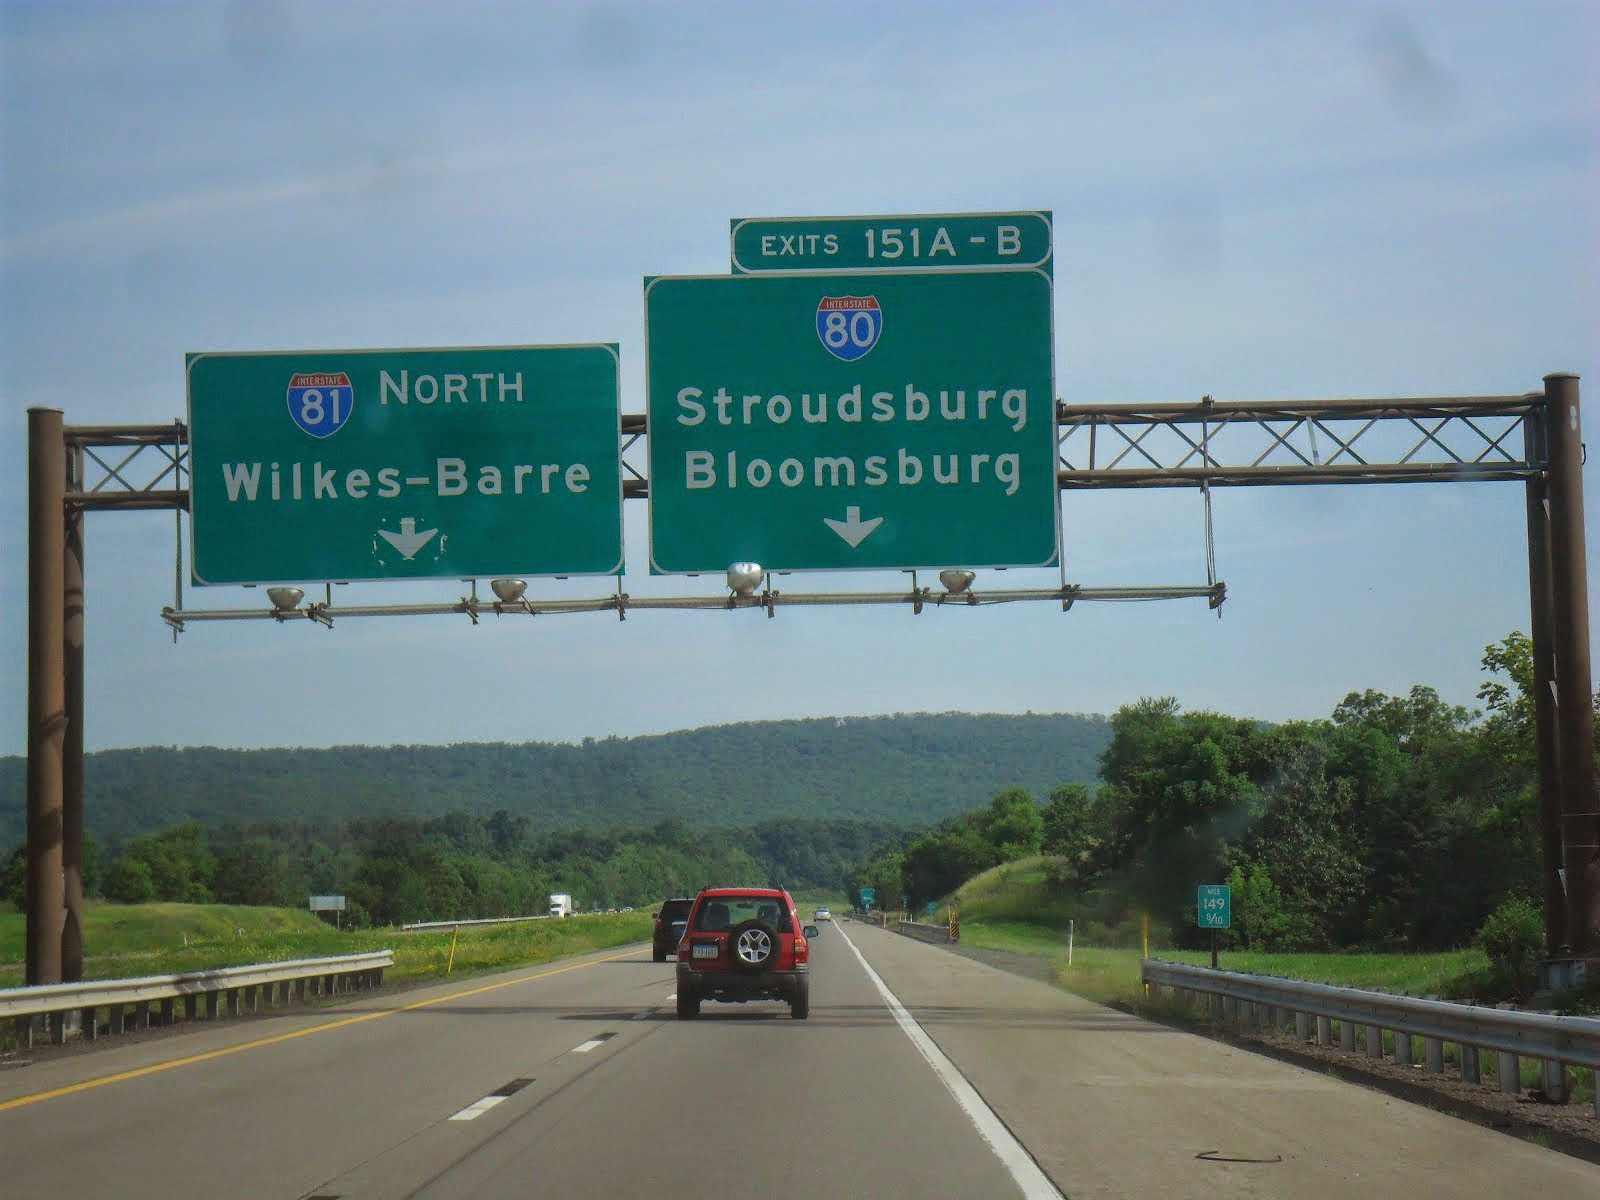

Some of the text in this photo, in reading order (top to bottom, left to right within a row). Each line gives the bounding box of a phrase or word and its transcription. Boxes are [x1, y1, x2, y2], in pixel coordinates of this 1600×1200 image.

[761, 233, 839, 256] EXITS
[865, 227, 957, 259] 151A
[997, 225, 1022, 255] B
[825, 299, 872, 310] INTERSTATE
[824, 311, 876, 348] 80
[296, 375, 344, 387] INTERSTATE
[378, 369, 525, 405] NORTH
[300, 388, 342, 425] 81
[676, 383, 1028, 432] Stroudsburg
[221, 456, 591, 502] Wilkes-Barre
[685, 447, 1020, 496] Bloomsburg
[1204, 898, 1225, 909] 149
